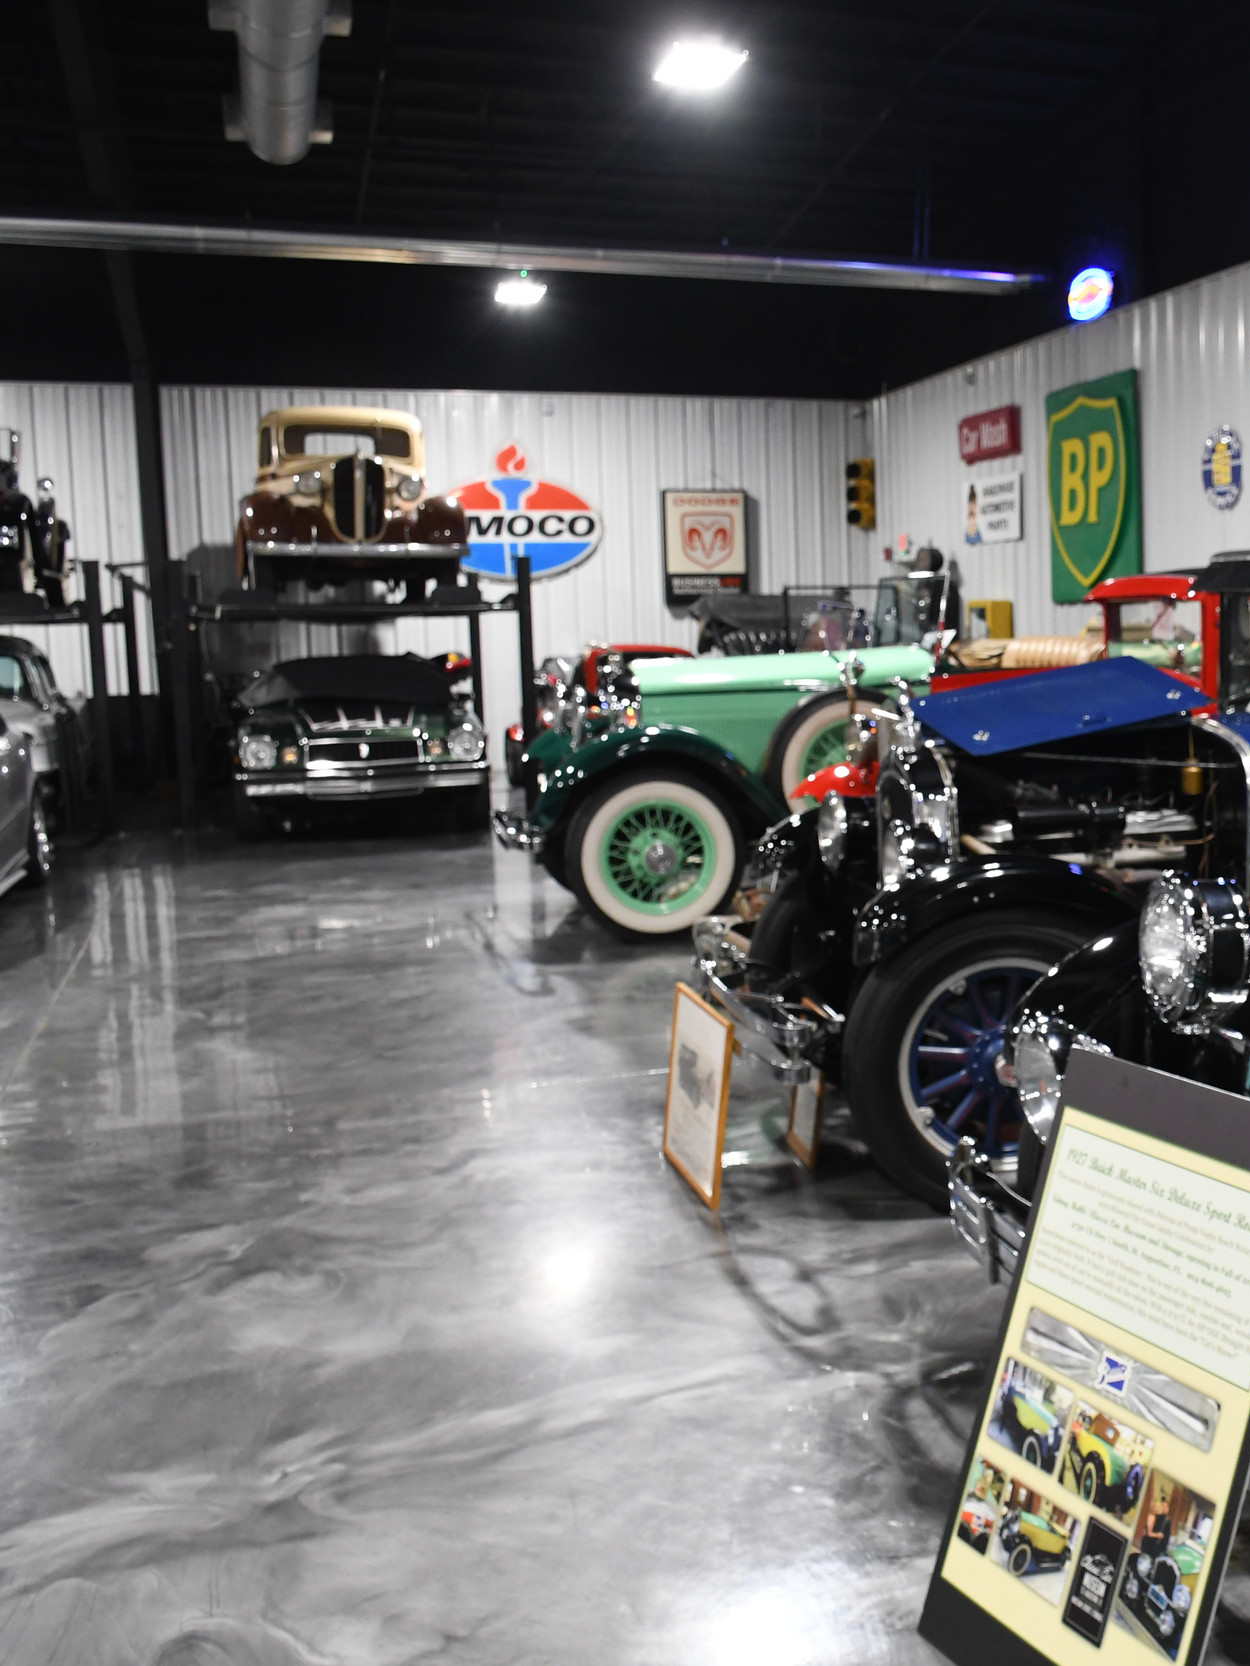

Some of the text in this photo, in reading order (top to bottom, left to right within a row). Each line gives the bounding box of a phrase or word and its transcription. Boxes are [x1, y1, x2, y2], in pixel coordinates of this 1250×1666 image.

[961, 419, 1010, 455] Car Wash
[1058, 430, 1115, 527] BP
[673, 495, 741, 507] DODGE
[467, 514, 595, 537] MOCO
[1114, 1168, 1148, 1191] Master
[1148, 1180, 1165, 1198] Six
[1166, 1187, 1202, 1213] Deluxe
[1203, 1201, 1233, 1225] Sport
